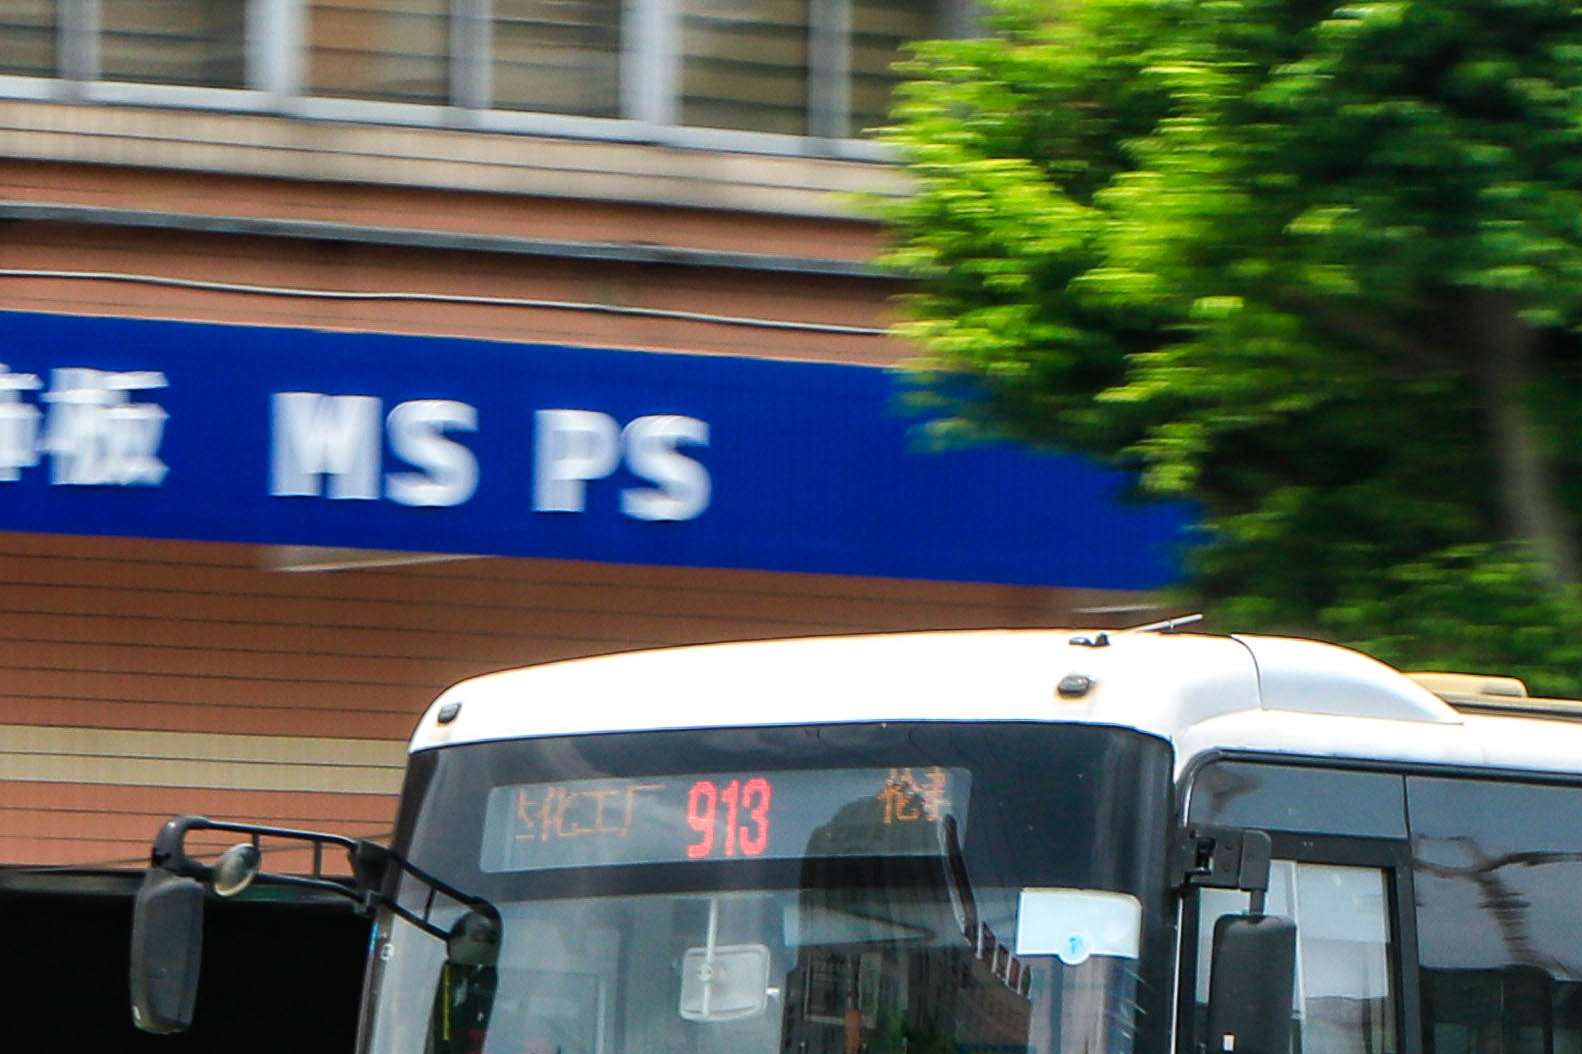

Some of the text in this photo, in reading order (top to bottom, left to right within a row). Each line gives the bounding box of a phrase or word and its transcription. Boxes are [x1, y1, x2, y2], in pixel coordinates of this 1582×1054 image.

[270, 392, 479, 506] MS
[532, 409, 711, 521] PS
[686, 777, 772, 858] 913
